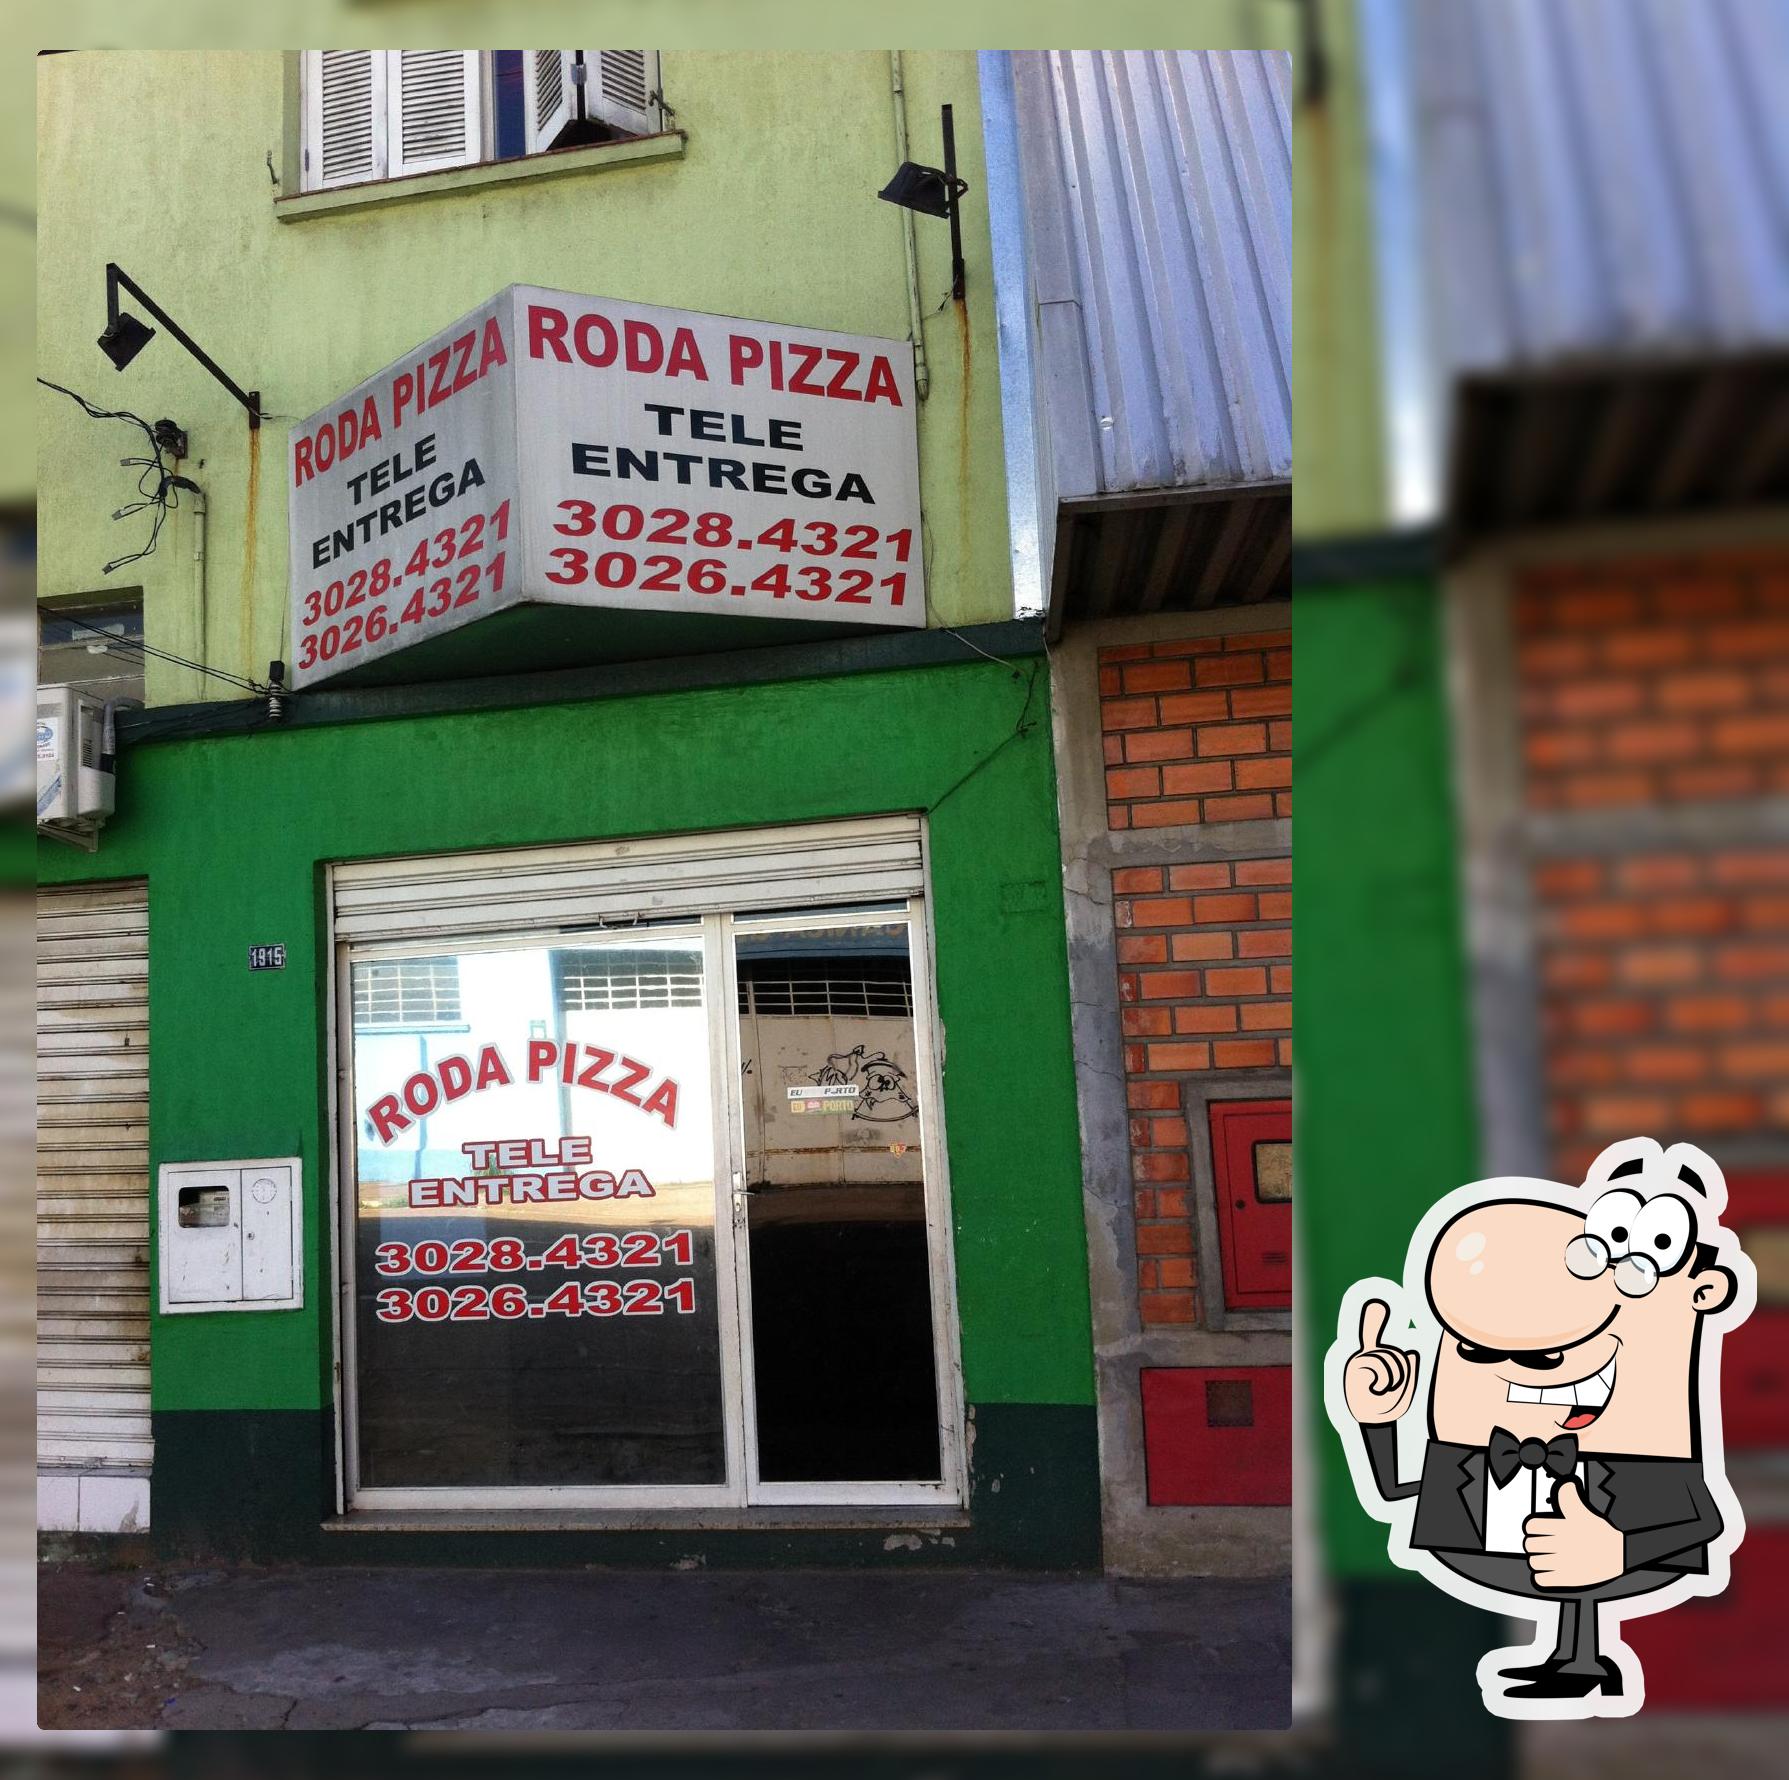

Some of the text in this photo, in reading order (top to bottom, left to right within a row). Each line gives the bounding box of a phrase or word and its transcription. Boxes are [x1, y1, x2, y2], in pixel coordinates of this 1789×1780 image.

[526, 304, 903, 407] RODA PIZZA
[294, 316, 508, 487] RODA PIZZA
[643, 402, 805, 453] TELE
[346, 432, 437, 507] TELE
[570, 441, 876, 506] ENTREGA
[312, 457, 487, 570] ENTREGA
[553, 498, 913, 564] 3028.4321
[302, 499, 511, 628] 3028.4321
[545, 547, 907, 607] 3026.4321
[298, 551, 507, 671] 3026.4321
[251, 946, 282, 967] 1915
[367, 1038, 680, 1145] RODA PIZZA
[462, 1136, 593, 1170] TELE
[408, 1169, 655, 1208] ENTREGA
[375, 1230, 694, 1276] 3028.4321
[376, 1279, 695, 1323] 3026.4321
